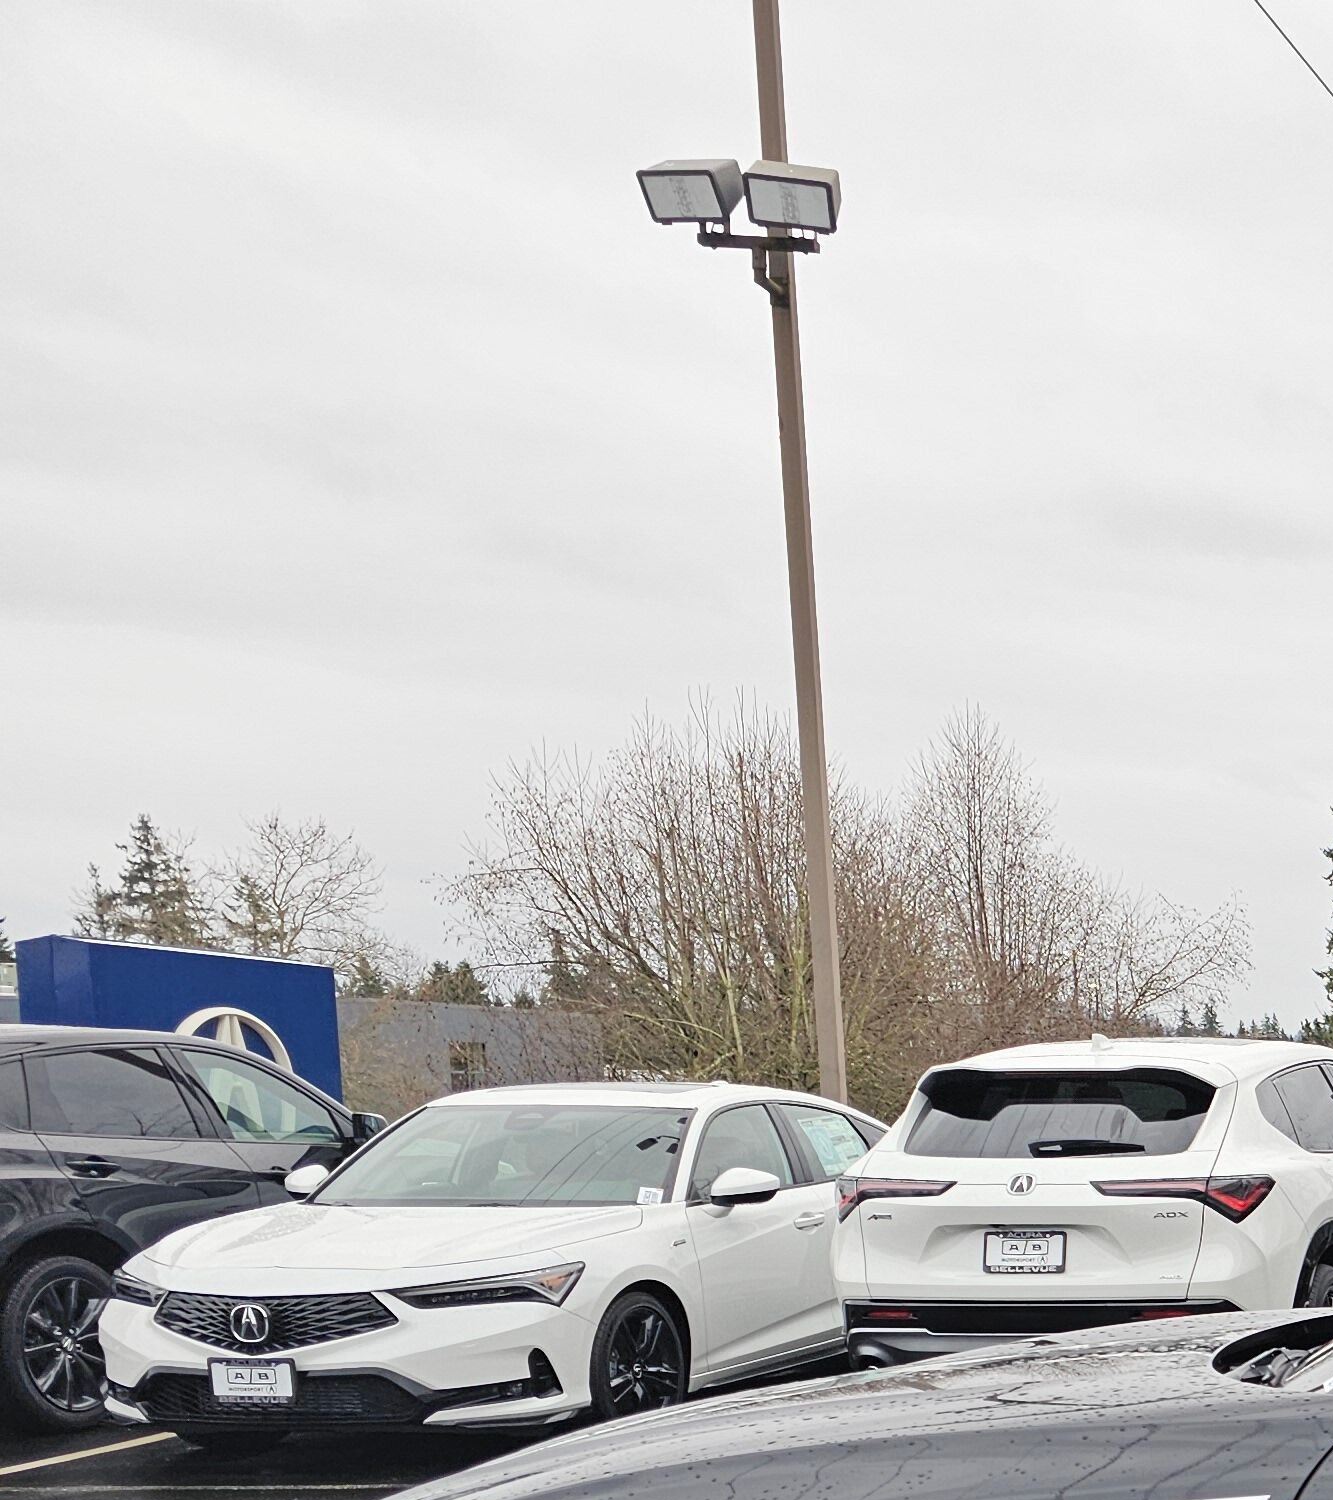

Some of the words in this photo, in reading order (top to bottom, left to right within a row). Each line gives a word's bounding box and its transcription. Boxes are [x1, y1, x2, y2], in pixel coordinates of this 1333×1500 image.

[1153, 1211, 1189, 1219] ADX
[234, 1372, 245, 1380] A
[258, 1372, 269, 1380] B
[219, 1396, 288, 1404] BELLEVUE
